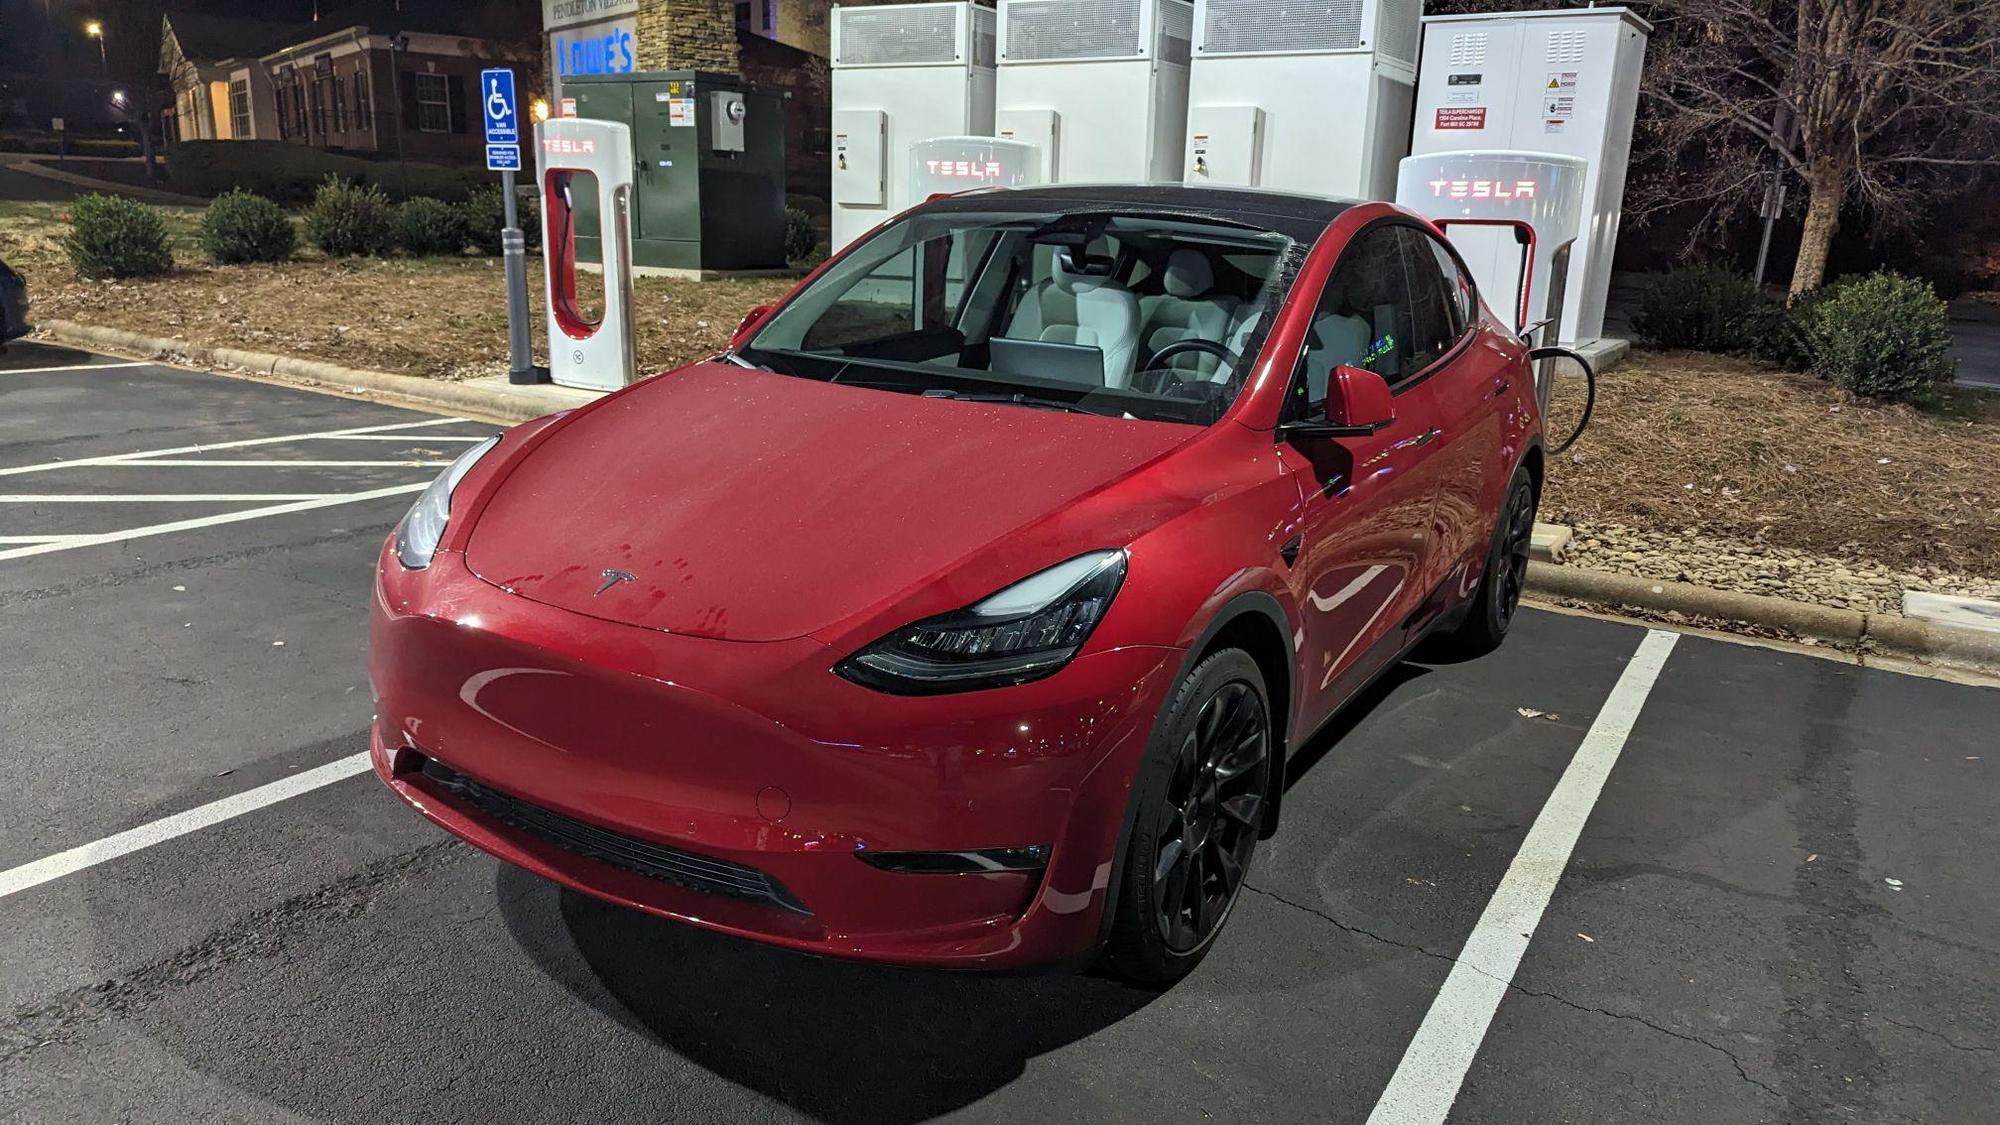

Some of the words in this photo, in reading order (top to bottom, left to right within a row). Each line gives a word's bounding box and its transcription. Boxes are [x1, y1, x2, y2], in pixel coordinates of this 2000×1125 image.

[543, 139, 594, 153] TESLA
[926, 161, 1000, 177] TESLA
[1429, 181, 1537, 198] TESLA
